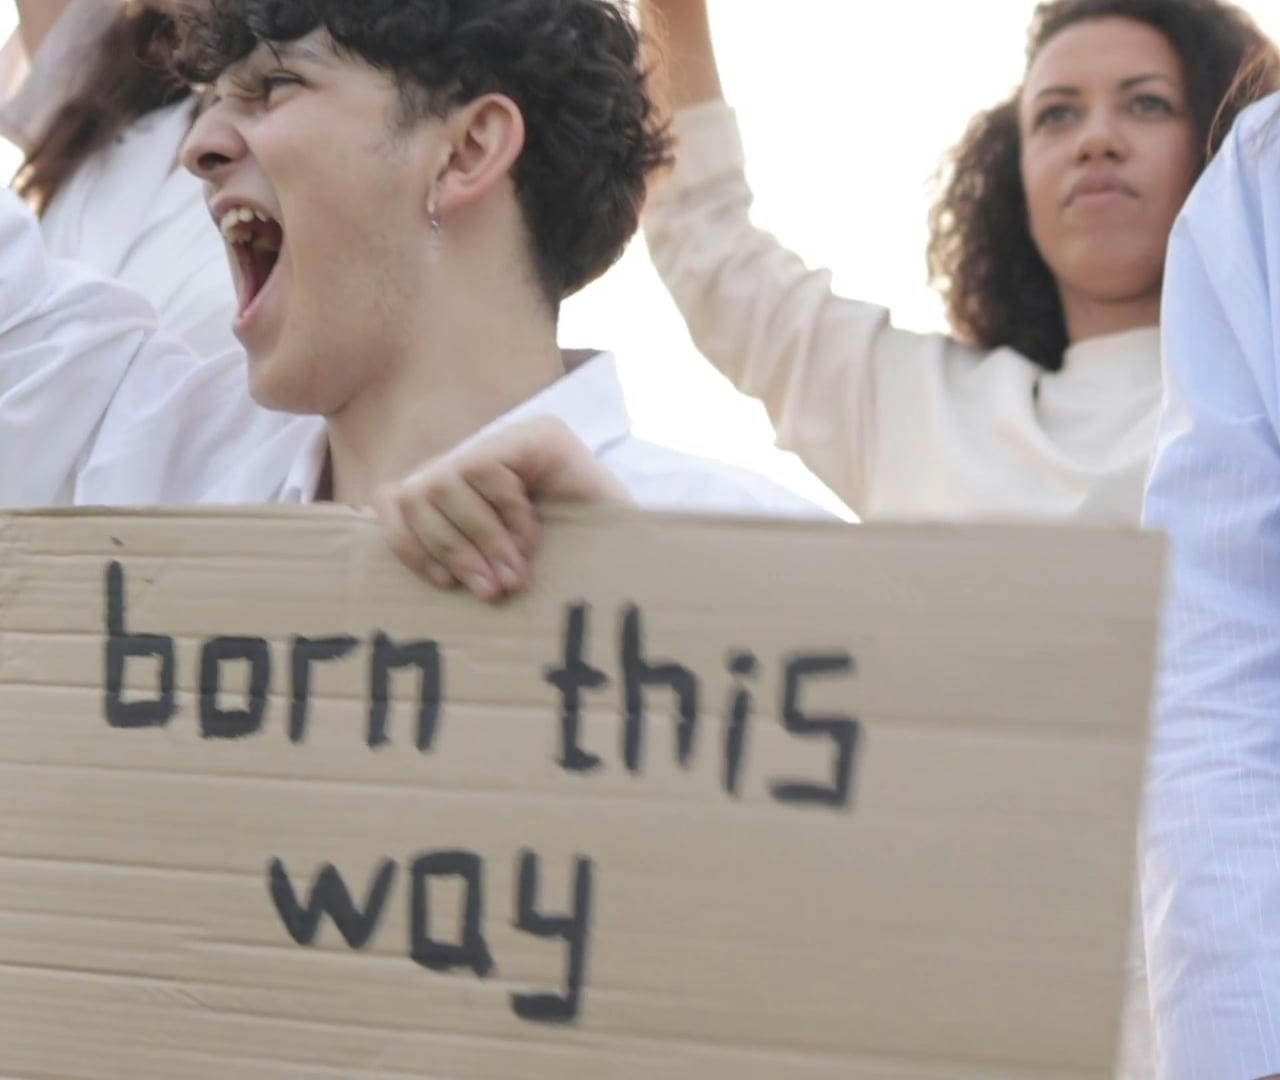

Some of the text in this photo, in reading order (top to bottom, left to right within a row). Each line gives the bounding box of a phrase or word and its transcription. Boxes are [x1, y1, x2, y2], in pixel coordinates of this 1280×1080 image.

[104, 560, 862, 810] born this
[267, 848, 594, 1025] way
